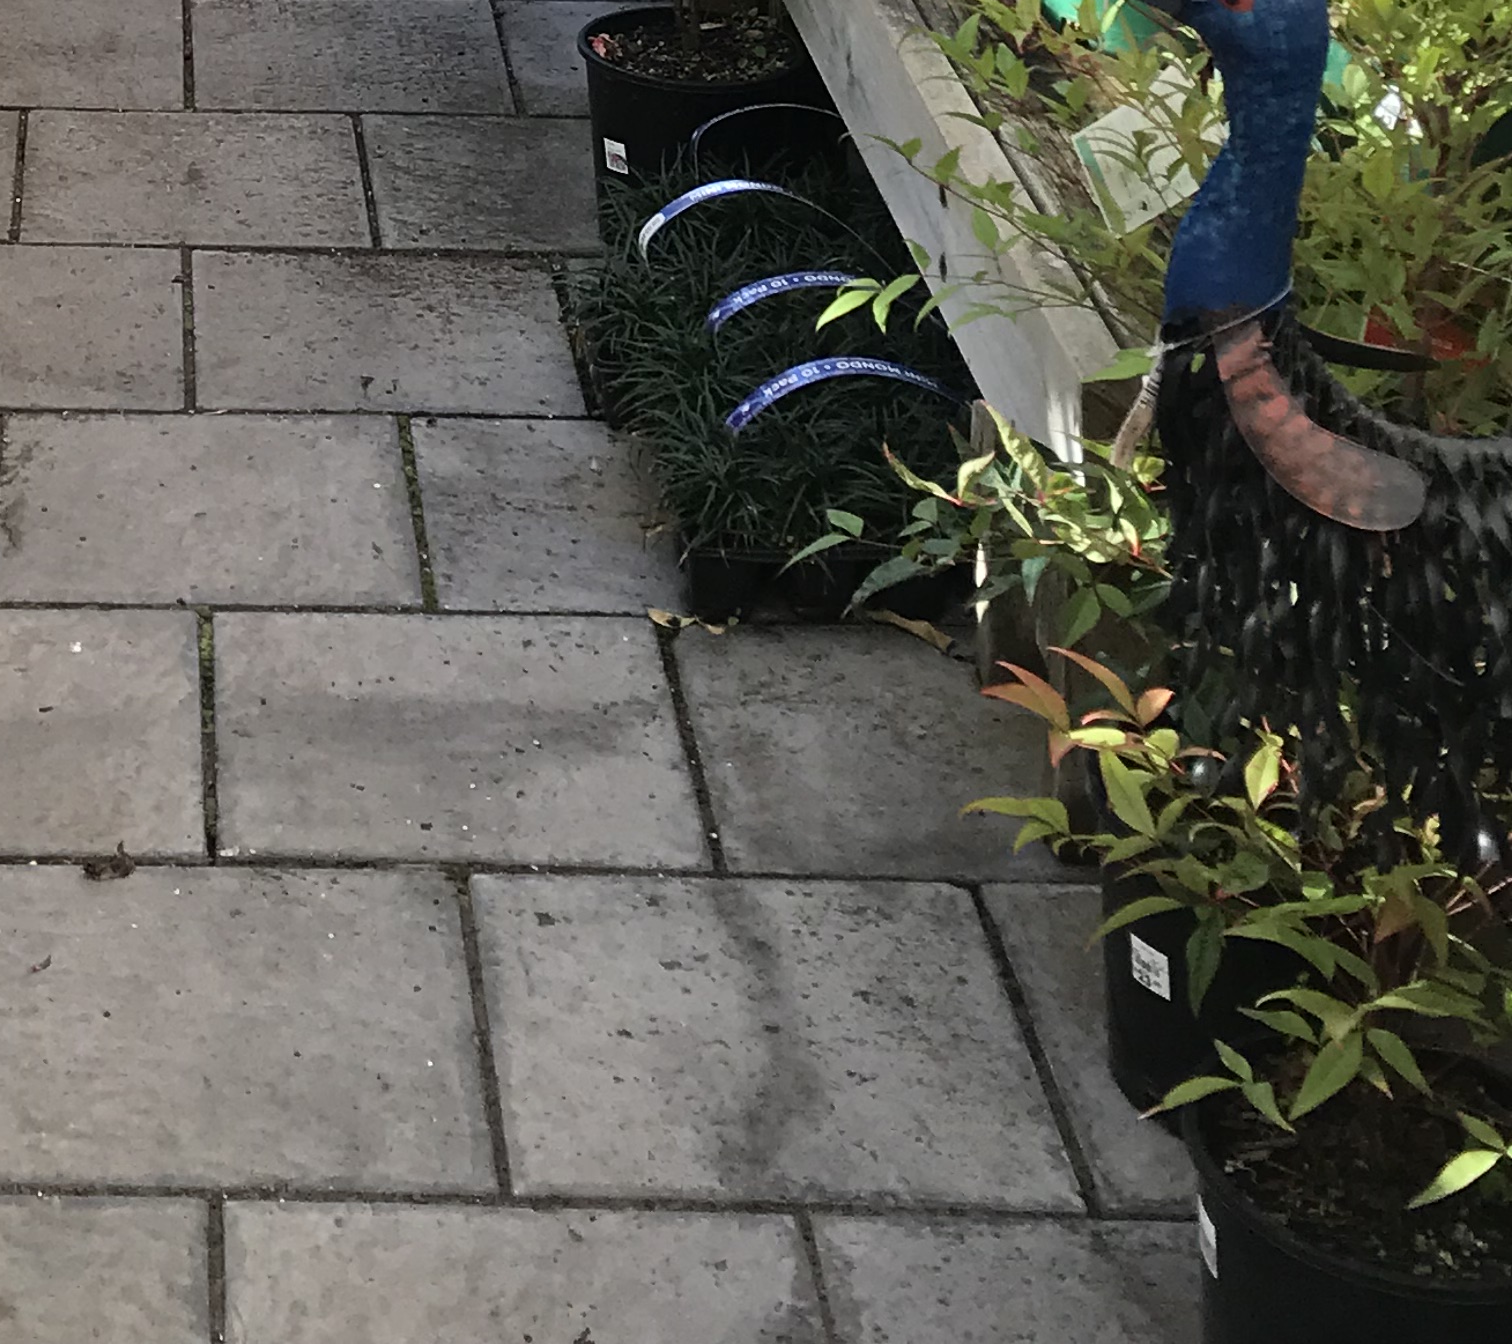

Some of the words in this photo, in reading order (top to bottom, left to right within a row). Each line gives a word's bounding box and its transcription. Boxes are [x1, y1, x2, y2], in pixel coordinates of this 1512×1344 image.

[771, 279, 788, 288] 10
[804, 275, 856, 283] ONDO
[801, 366, 820, 378] 10
[836, 360, 901, 375] MONDO
